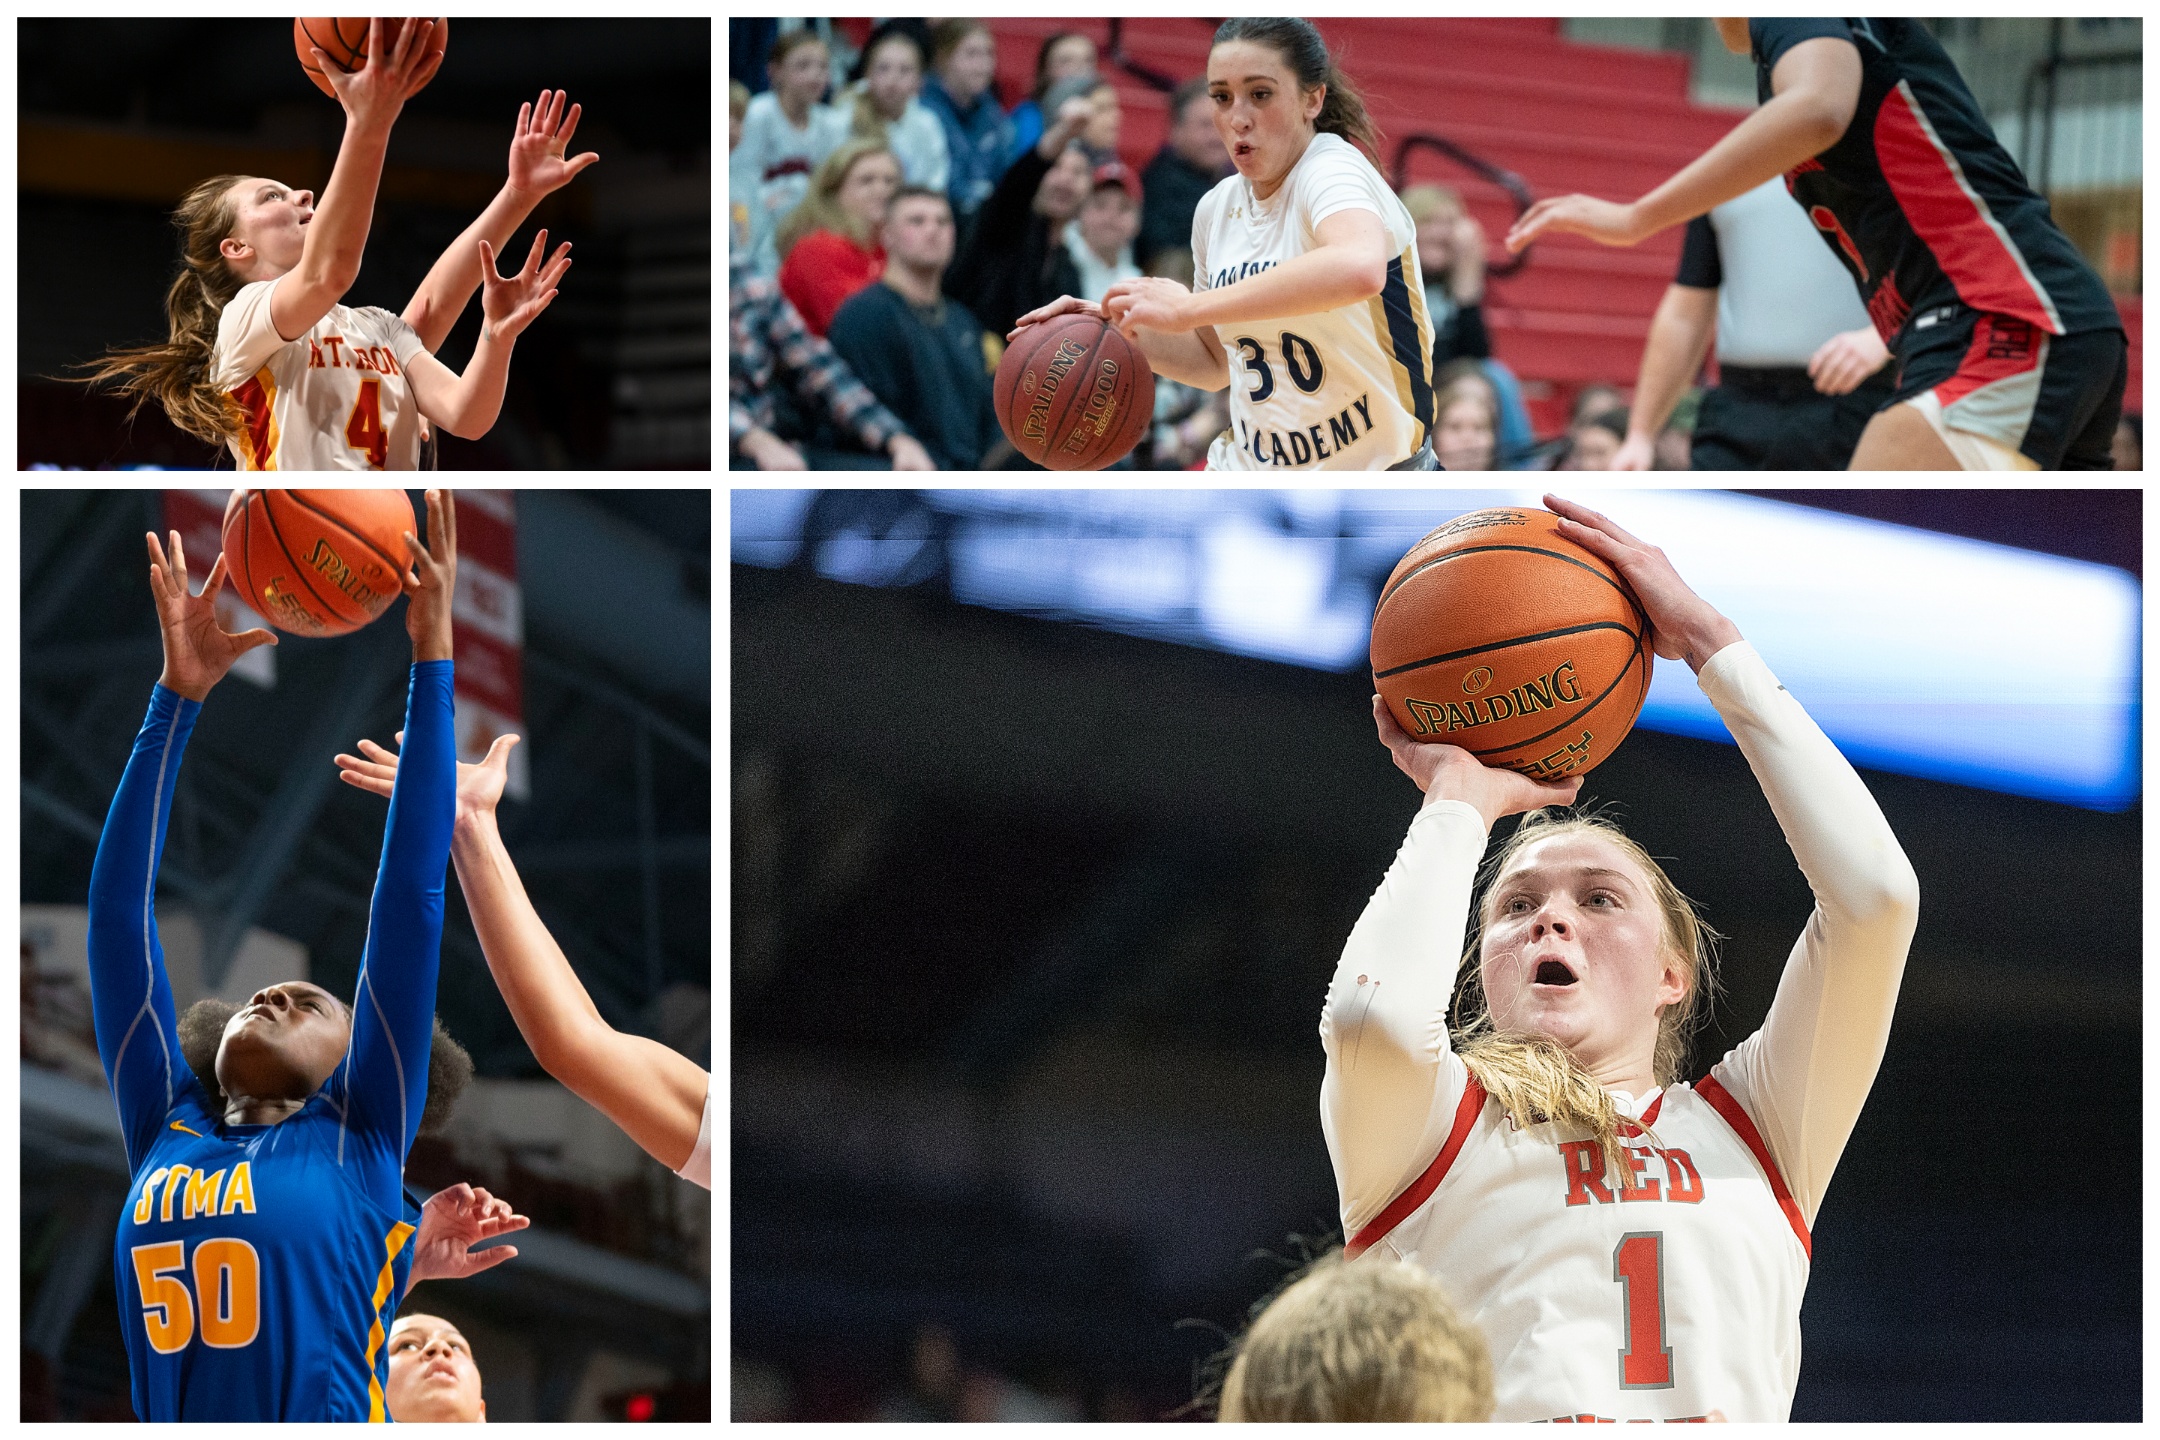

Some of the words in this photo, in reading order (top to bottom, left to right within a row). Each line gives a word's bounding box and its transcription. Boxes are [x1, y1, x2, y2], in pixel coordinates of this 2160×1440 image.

[1023, 337, 1090, 446] SPALDING
[1060, 359, 1118, 455] TF-1000
[1233, 330, 1327, 405] 30
[344, 378, 389, 471] 4
[1093, 396, 1117, 437] LEGACY
[1405, 659, 1584, 736] SPALDING
[133, 1161, 257, 1225] STMA
[1557, 1139, 1706, 1207] RED
[131, 1237, 261, 1355] 50
[1612, 1230, 1675, 1391] 1
